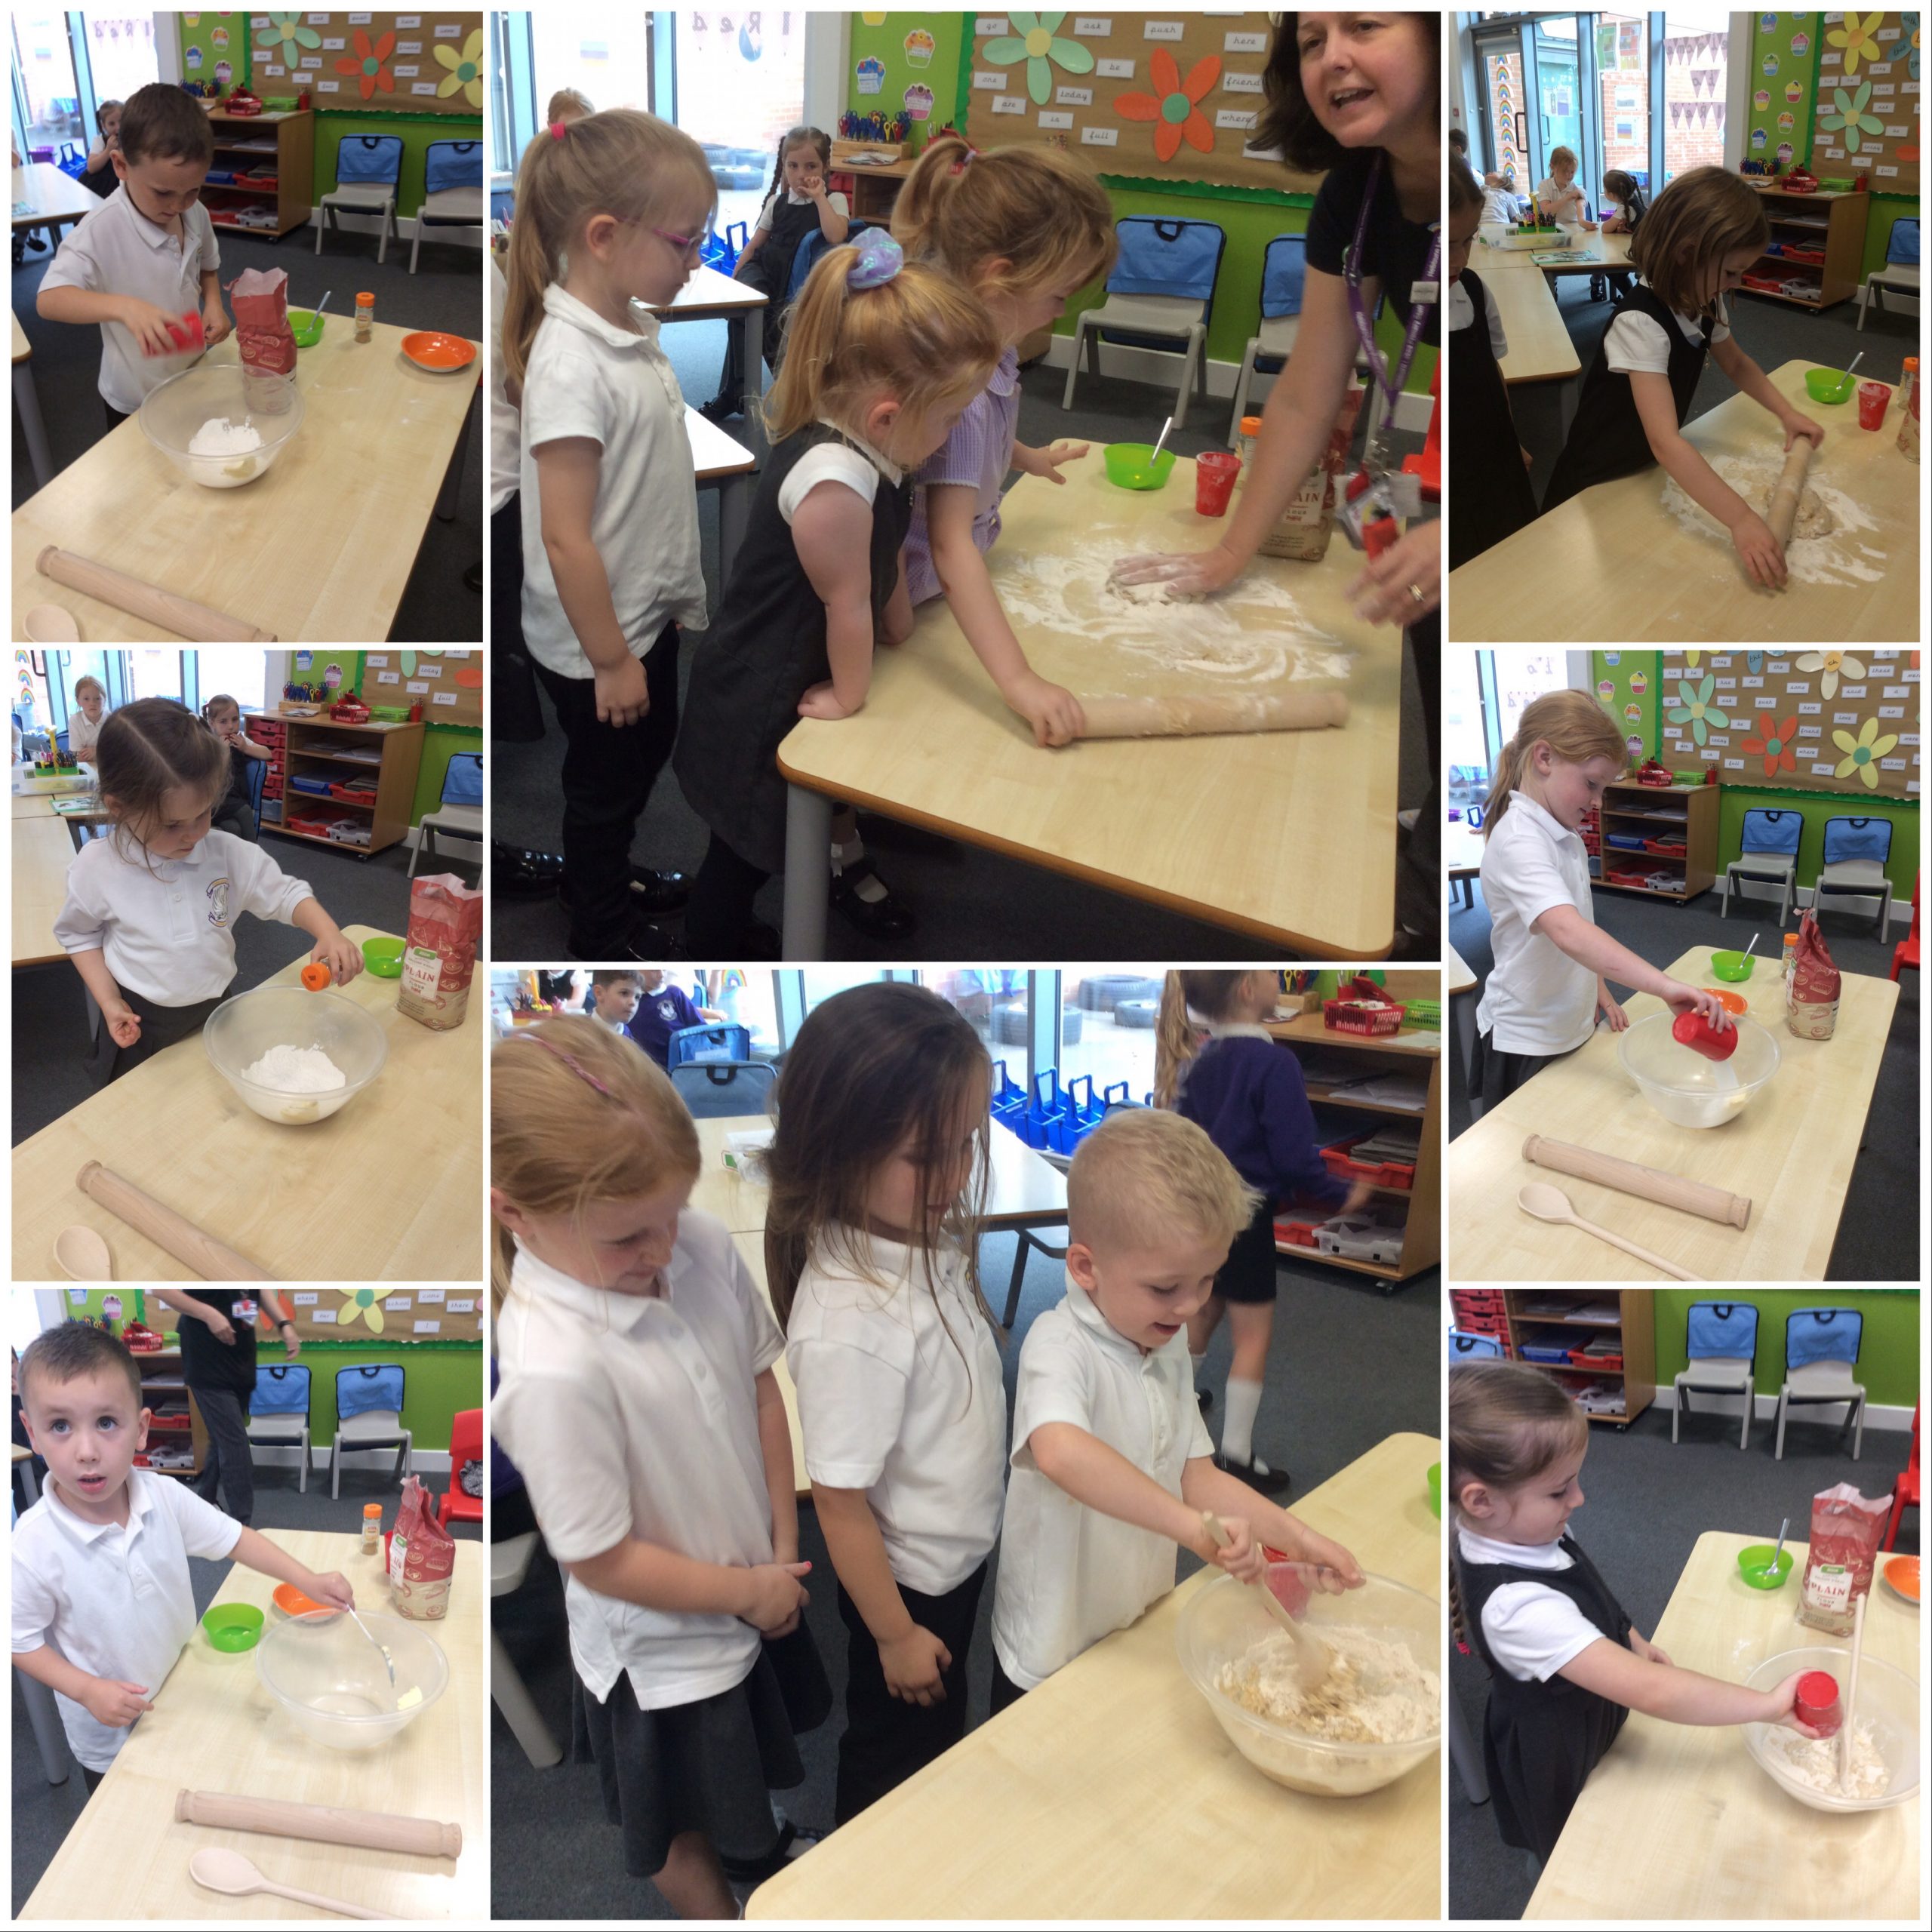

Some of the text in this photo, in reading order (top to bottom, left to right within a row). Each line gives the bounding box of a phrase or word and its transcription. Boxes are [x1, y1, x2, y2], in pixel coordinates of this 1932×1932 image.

[1150, 25, 1177, 35] push
[1232, 35, 1257, 45] here
[1226, 76, 1261, 87] friend
[1060, 90, 1088, 102] today
[1001, 100, 1017, 109] are
[1221, 114, 1253, 123] where
[1089, 131, 1110, 140] full
[1749, 654, 1762, 663] the
[405, 964, 435, 983] PLAIN
[1811, 1582, 1845, 1596] PLAIN
